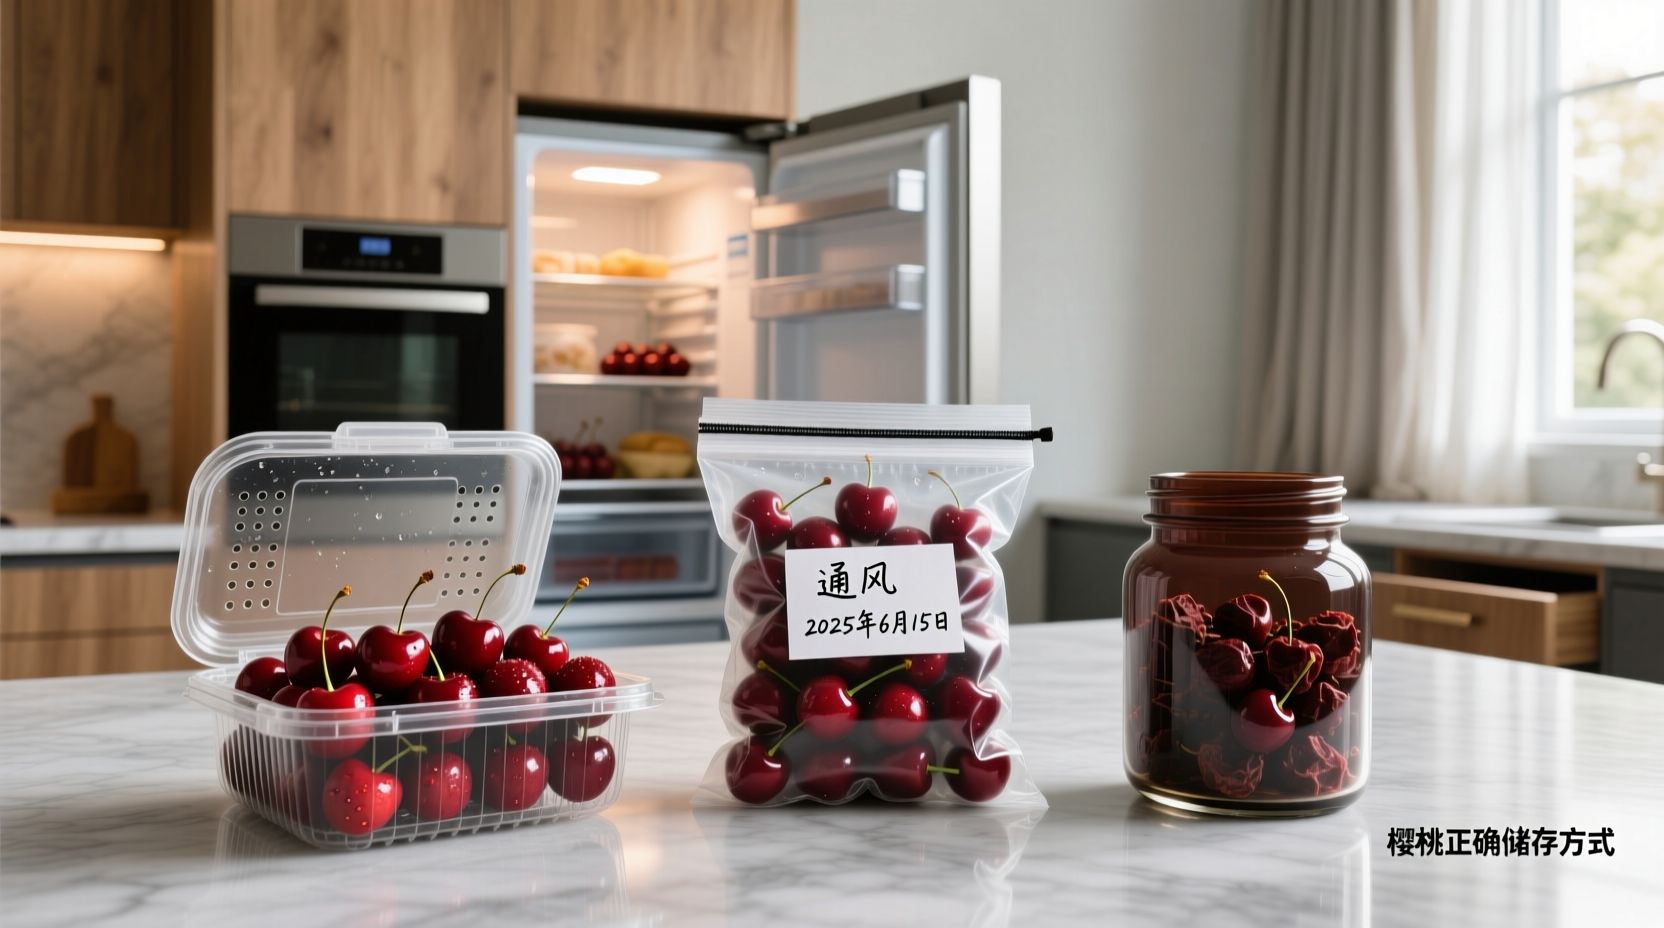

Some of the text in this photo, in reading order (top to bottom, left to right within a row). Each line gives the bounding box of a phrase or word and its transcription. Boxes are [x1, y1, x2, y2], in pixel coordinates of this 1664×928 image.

[817, 561, 898, 600] 通风
[804, 609, 949, 639] 2025年6月15日
